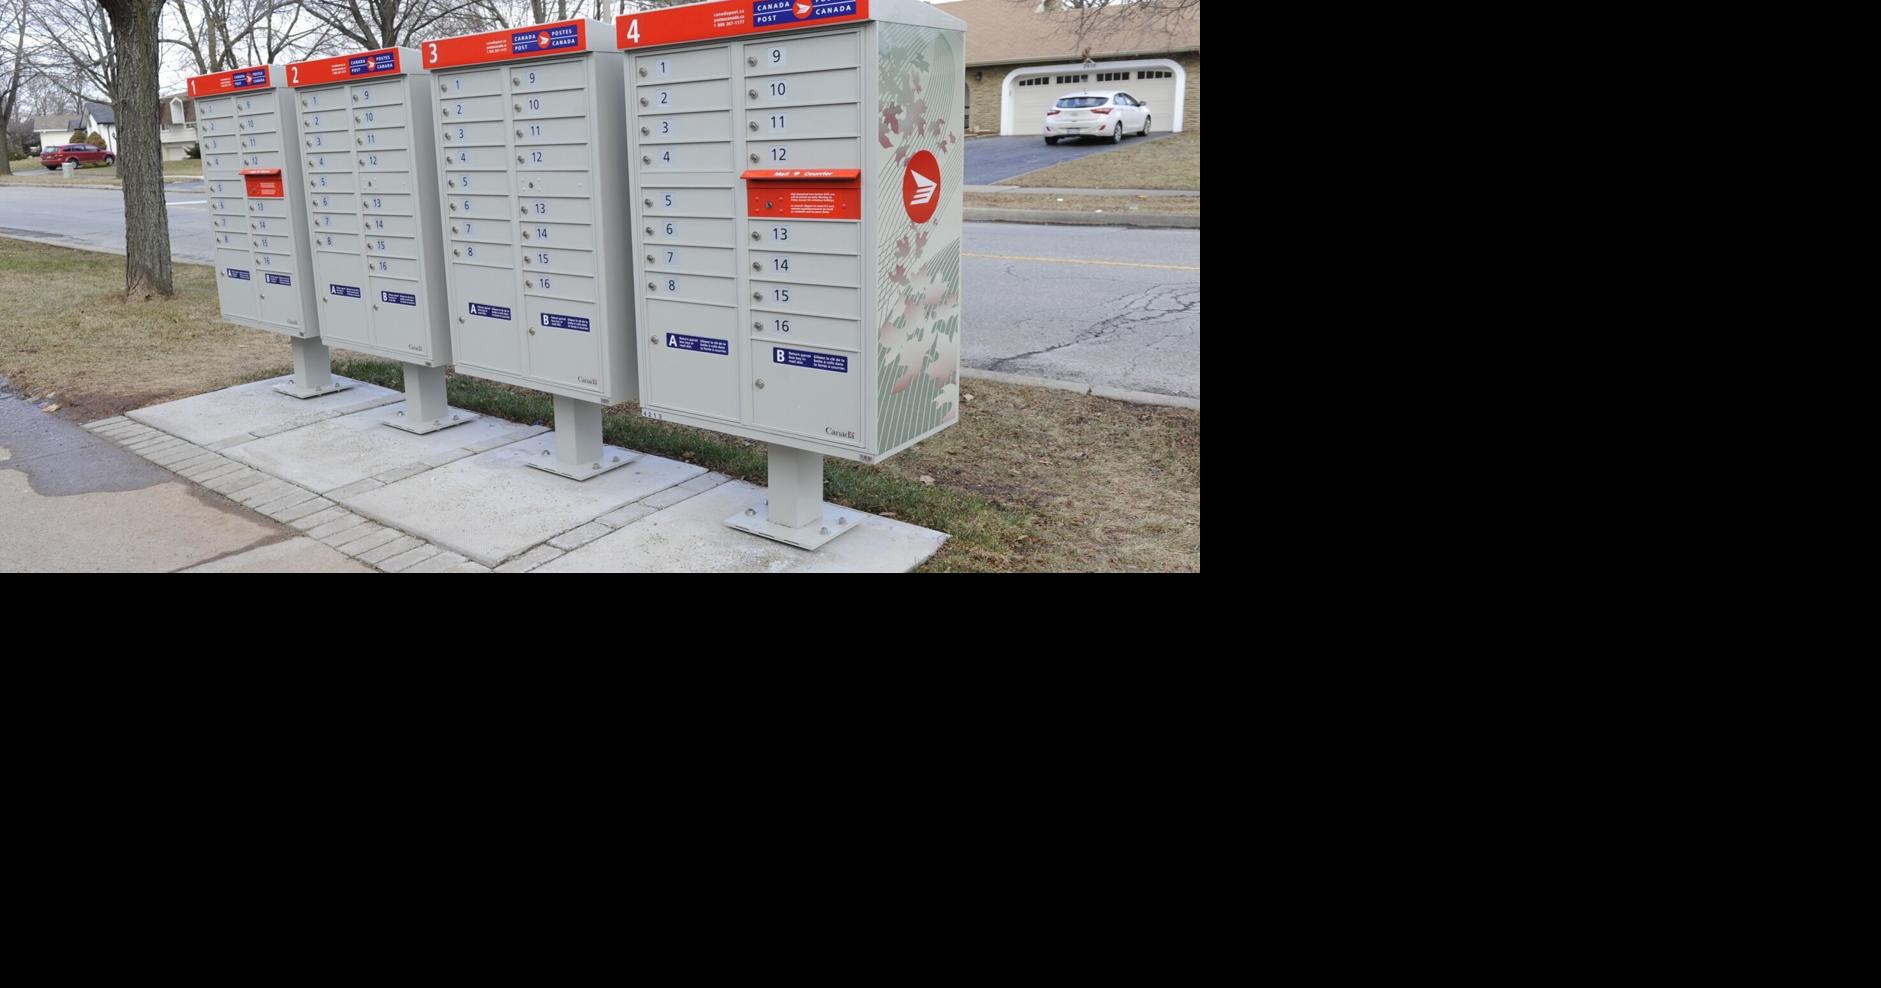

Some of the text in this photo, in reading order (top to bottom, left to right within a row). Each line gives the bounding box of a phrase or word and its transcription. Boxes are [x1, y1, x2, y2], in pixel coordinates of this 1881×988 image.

[757, 1, 790, 11] CANADA
[816, 5, 851, 15] CANADA
[627, 19, 640, 43] 4
[429, 43, 437, 63] 3
[772, 50, 780, 63] 9
[660, 62, 665, 73] 1
[292, 67, 298, 83] 2
[529, 73, 535, 83] 9
[191, 80, 196, 94] 1
[456, 80, 459, 89] 1
[770, 82, 786, 96] 10
[661, 92, 668, 104] 2
[457, 104, 462, 115] 2
[529, 99, 540, 110] 10
[662, 122, 668, 133] 3
[771, 116, 784, 128] 11
[459, 129, 464, 138] 3
[531, 126, 540, 136] 11
[461, 153, 466, 162] 4
[532, 152, 542, 162] 12
[663, 151, 670, 162] 4
[772, 148, 786, 160] 12
[462, 177, 468, 187] 5
[464, 200, 470, 210] 6
[665, 195, 672, 206] 5
[535, 203, 546, 213] 13
[466, 224, 471, 233] 7
[537, 229, 547, 238] 14
[666, 223, 673, 235] 6
[773, 228, 788, 240] 13
[468, 247, 473, 256] 8
[538, 254, 549, 264] 15
[667, 252, 674, 263] 7
[774, 259, 788, 271] 14
[540, 278, 550, 288] 16
[668, 280, 676, 291] 8
[774, 289, 789, 302] 15
[471, 304, 477, 314] A
[543, 315, 549, 325] B
[775, 320, 789, 332] 16
[669, 335, 677, 347] A
[777, 350, 785, 362] B
